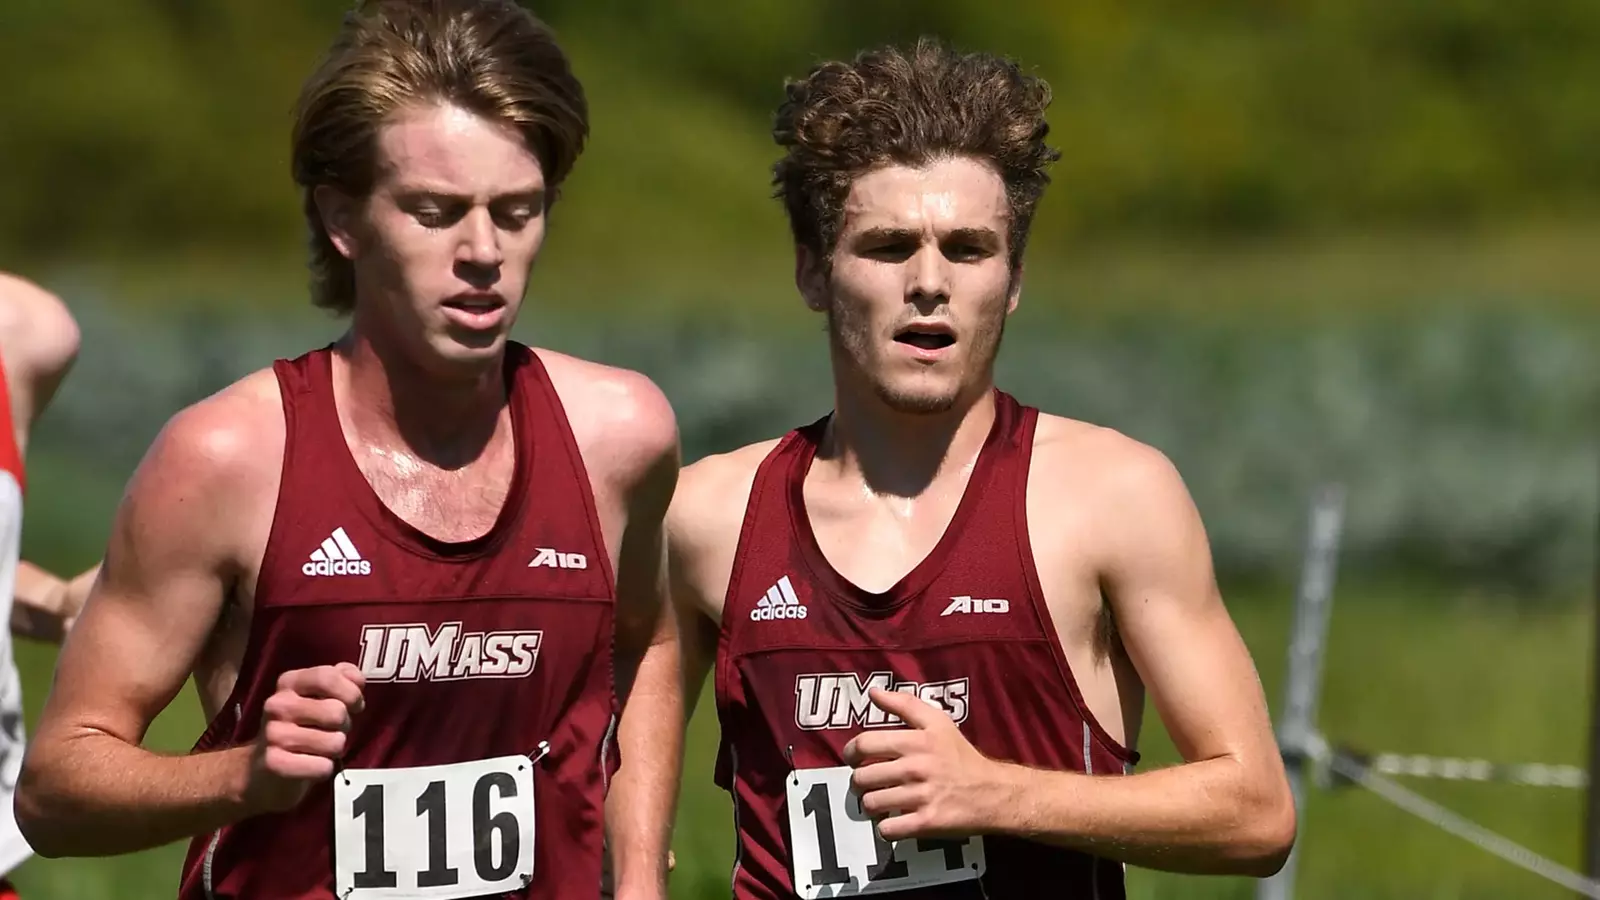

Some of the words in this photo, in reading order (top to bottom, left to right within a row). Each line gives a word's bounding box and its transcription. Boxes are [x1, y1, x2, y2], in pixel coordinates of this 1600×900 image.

[302, 559, 371, 577] adidas
[751, 603, 807, 621] adidas
[352, 772, 520, 889] 116
